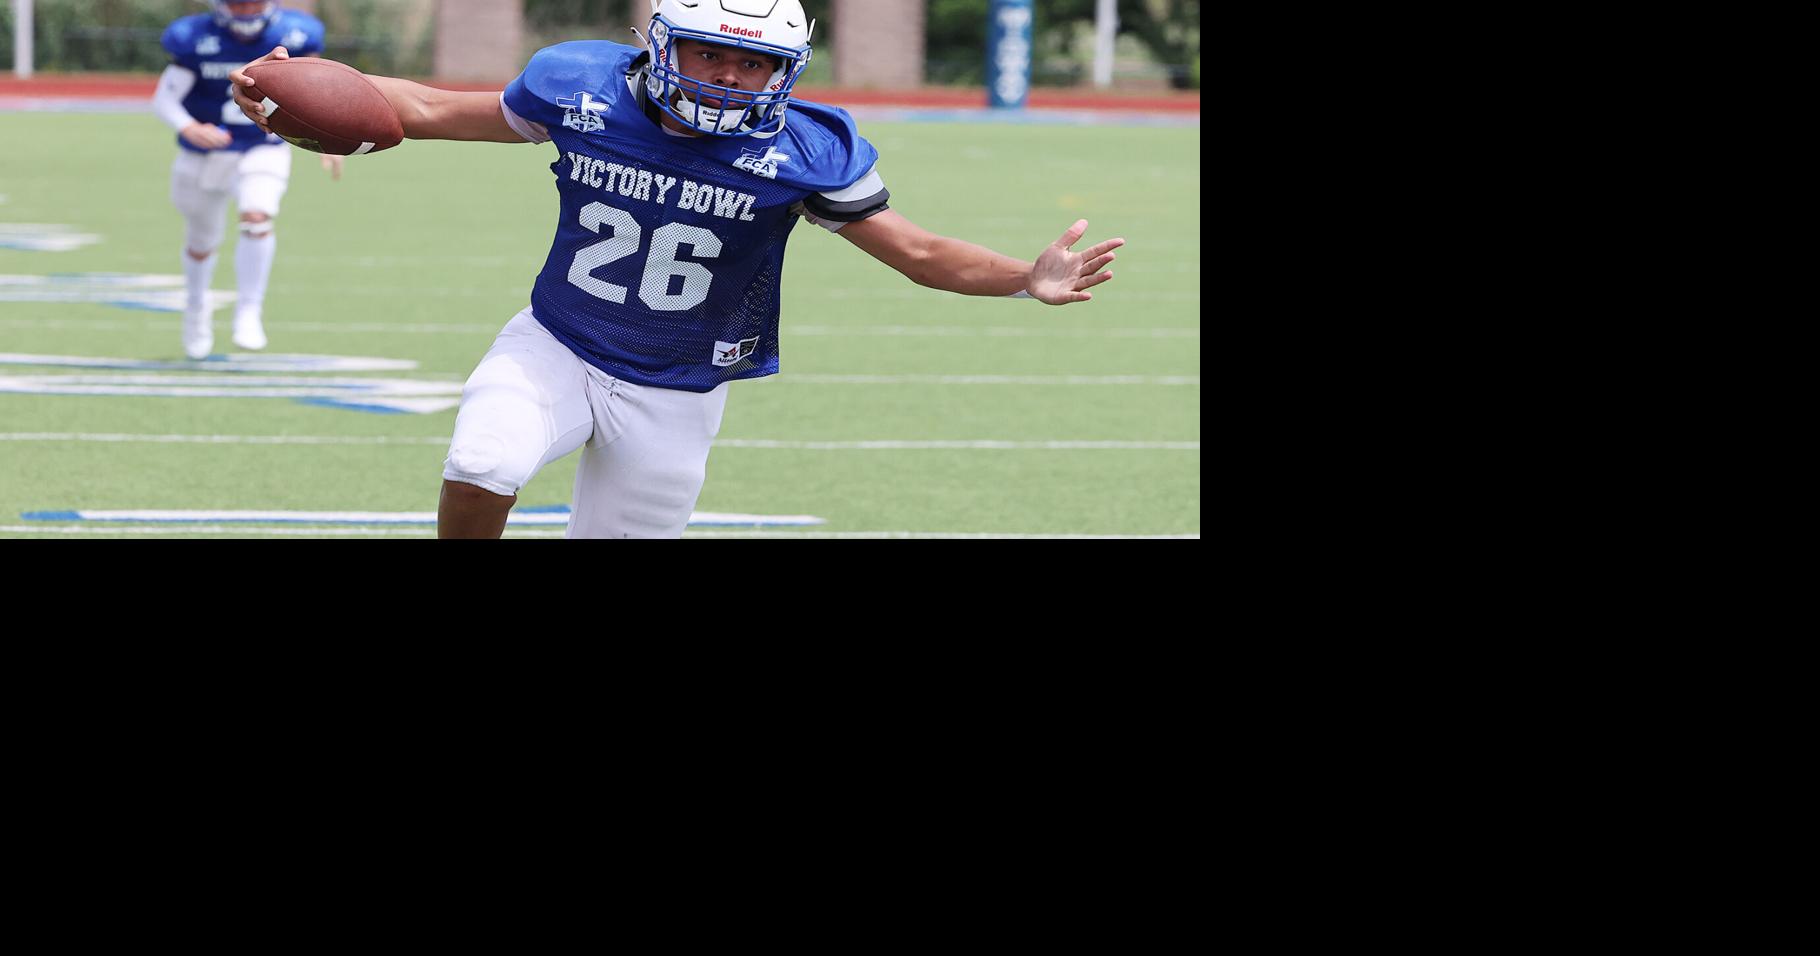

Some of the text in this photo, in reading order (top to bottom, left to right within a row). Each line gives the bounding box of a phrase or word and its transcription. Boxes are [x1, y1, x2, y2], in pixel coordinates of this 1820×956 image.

[719, 24, 763, 38] Riddell
[570, 114, 598, 125] FCA
[742, 158, 771, 173] FCA
[567, 152, 756, 221] VICTORY BOWL
[567, 201, 723, 311] 26
